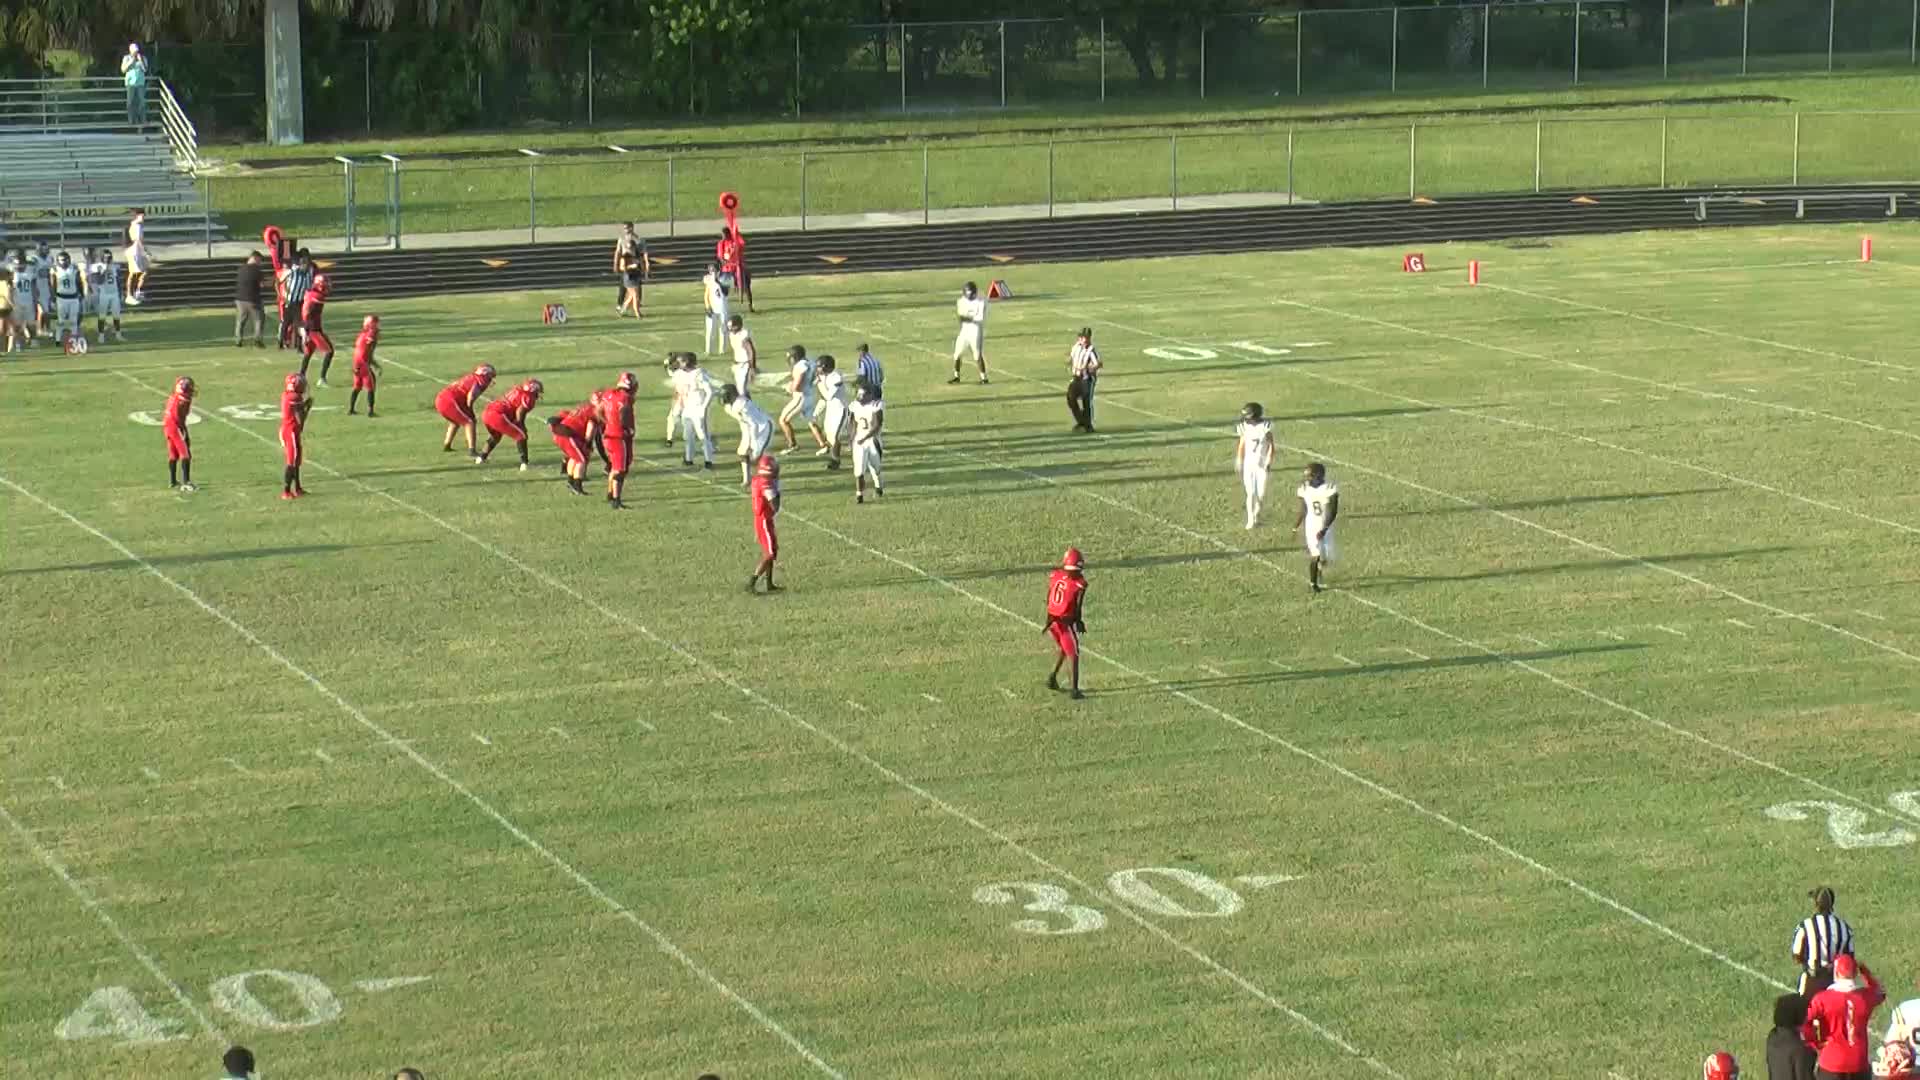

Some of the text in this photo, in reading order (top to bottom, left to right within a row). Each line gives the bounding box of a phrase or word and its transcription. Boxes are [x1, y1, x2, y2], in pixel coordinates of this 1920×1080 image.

[1410, 256, 1423, 271] G
[549, 305, 568, 324] 20
[68, 337, 88, 354] 30
[1251, 438, 1260, 452] 7
[1313, 500, 1323, 516] 8
[1052, 579, 1068, 605] 6
[972, 867, 1245, 935] 30
[54, 968, 343, 1046] 40
